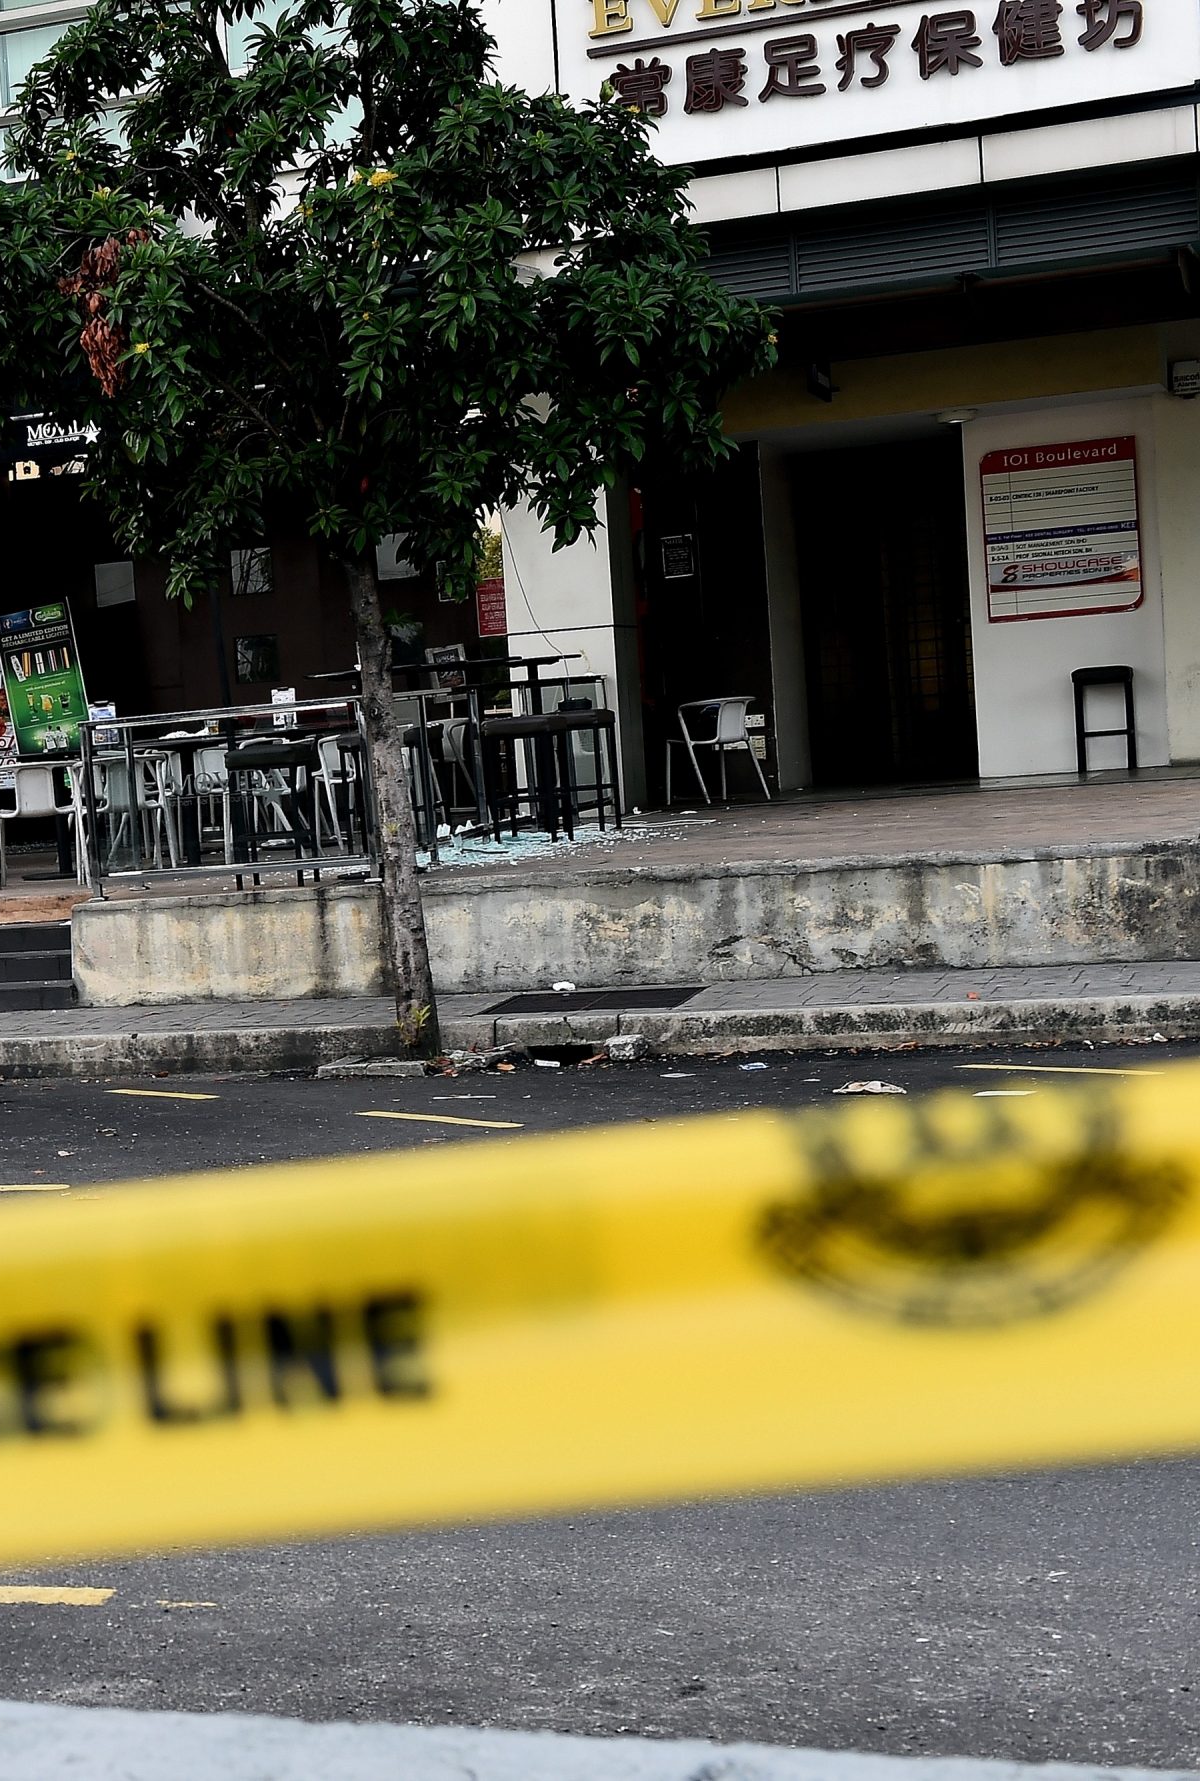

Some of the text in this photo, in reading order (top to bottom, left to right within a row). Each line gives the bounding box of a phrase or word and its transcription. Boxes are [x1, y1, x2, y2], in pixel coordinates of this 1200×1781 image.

[1003, 443, 1117, 467] IOI Boulevard
[1021, 556, 1122, 573] SHOWCASE
[1022, 568, 1080, 579] PROPERTIES
[44, 624, 69, 633] EDITION
[134, 1289, 436, 1428] LINE
